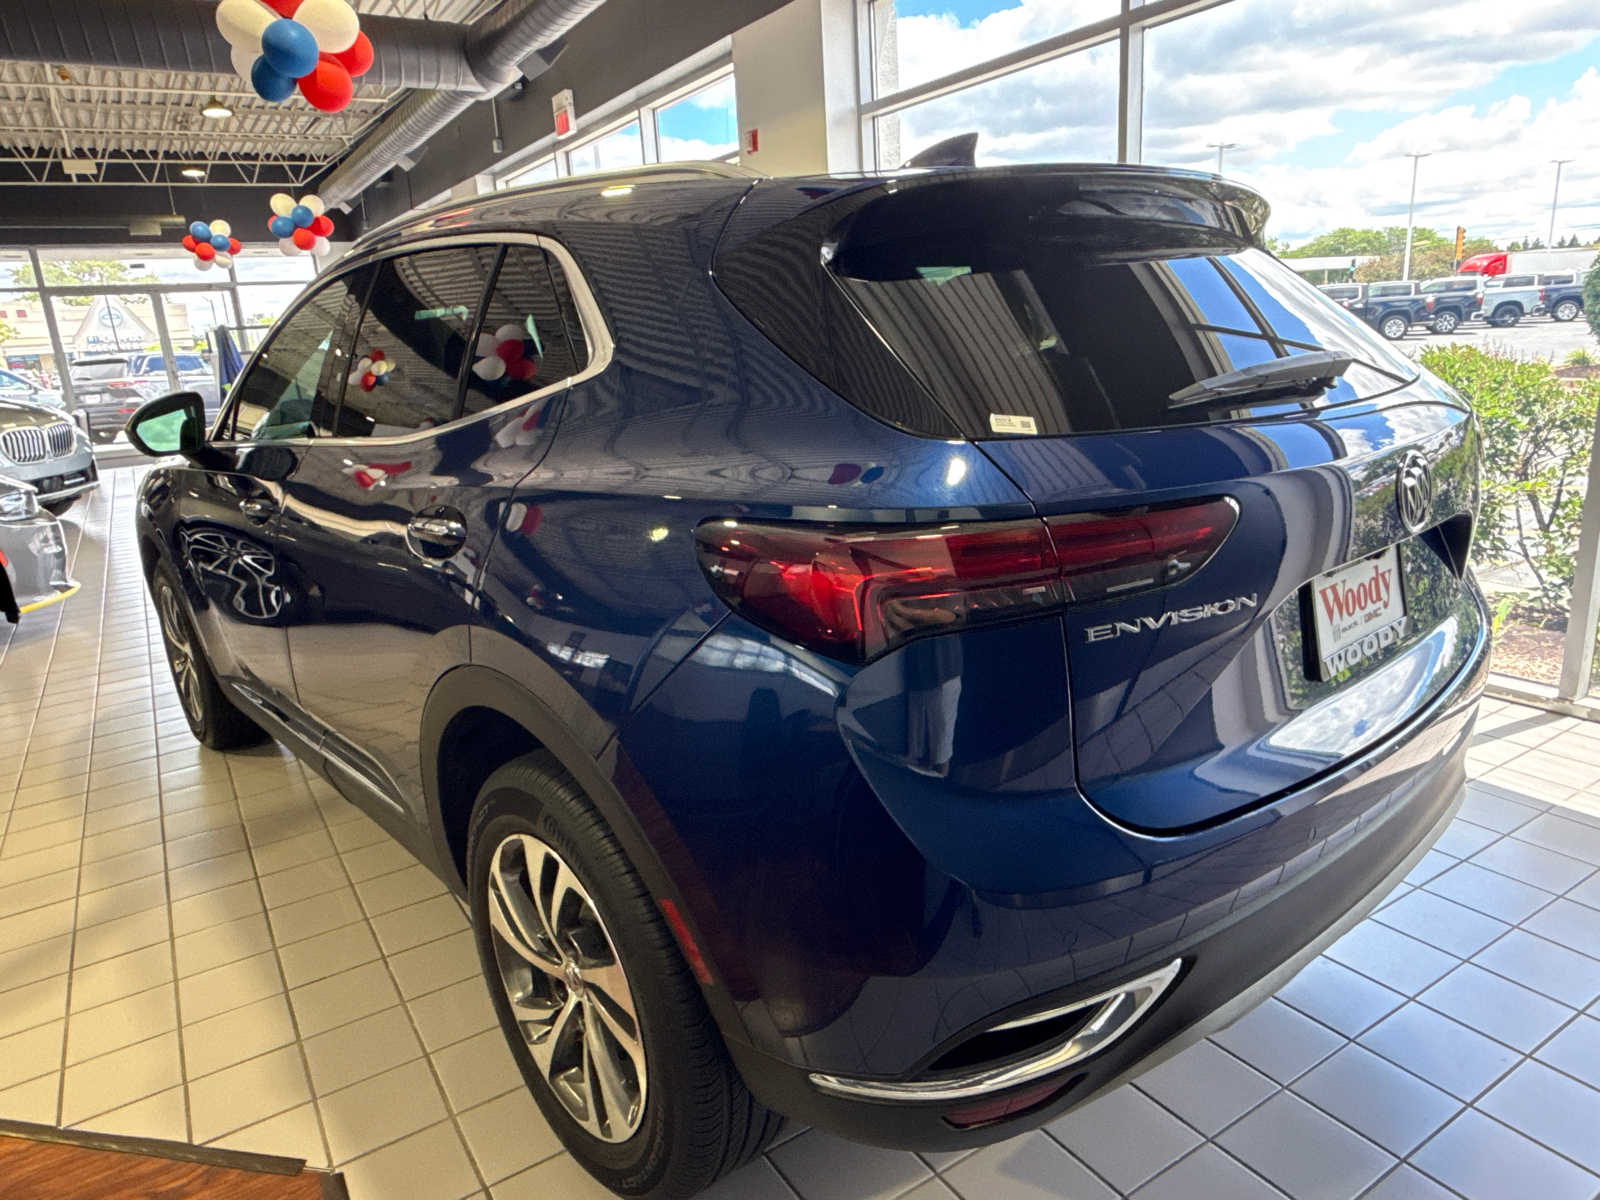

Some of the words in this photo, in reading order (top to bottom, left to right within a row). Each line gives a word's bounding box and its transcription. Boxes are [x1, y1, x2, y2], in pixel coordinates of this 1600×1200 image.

[1085, 593, 1258, 643] ENVISION
[1318, 564, 1392, 625] Woody
[1341, 621, 1359, 634] BUICK
[1364, 607, 1382, 623] GMC
[1324, 616, 1407, 677] WOODY
